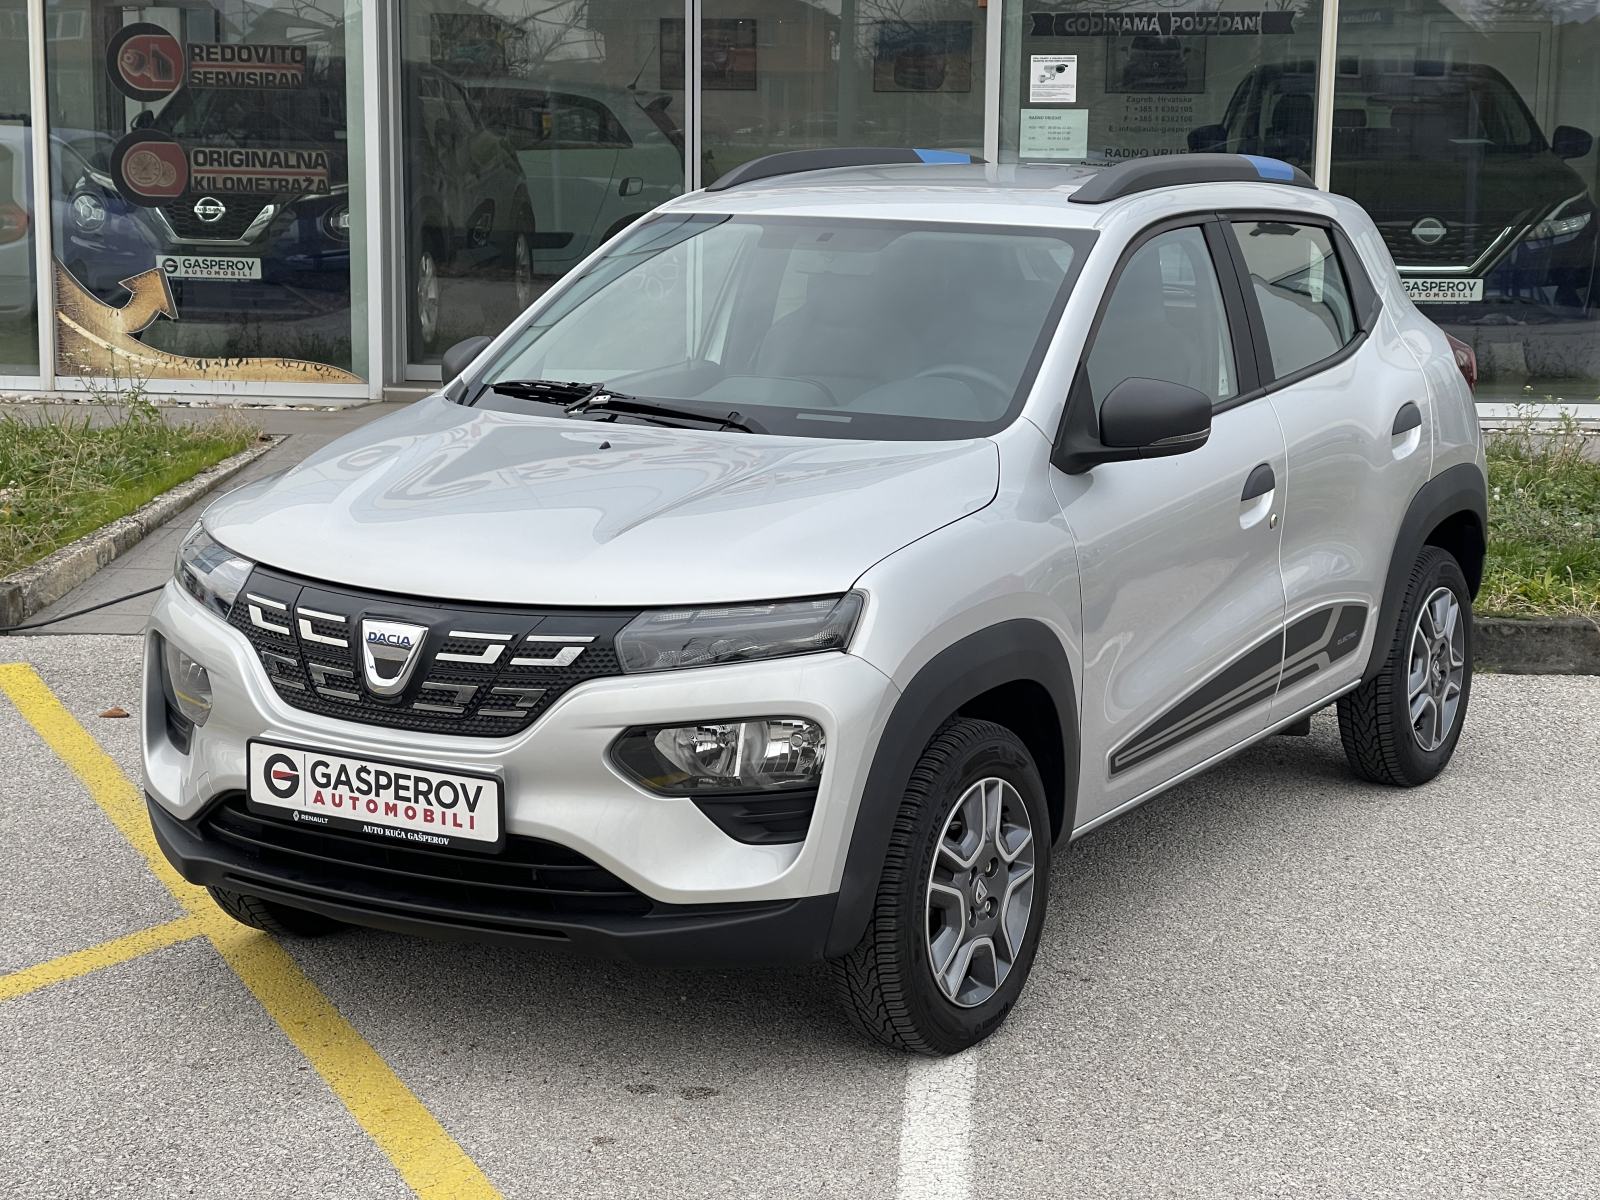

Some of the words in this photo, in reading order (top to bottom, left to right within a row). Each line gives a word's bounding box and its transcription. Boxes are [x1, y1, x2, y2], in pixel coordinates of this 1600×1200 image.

[1065, 17, 1160, 32] GODINAMA
[1171, 17, 1261, 32] POUZDANI
[191, 45, 305, 62] REDOVITO
[191, 71, 304, 87] SERVISIRAN
[193, 150, 327, 168] ORIGINALNA
[1105, 148, 1149, 158] RADNO
[193, 175, 328, 192] KILOMETRAŽA
[184, 269, 252, 277] AUTOMOBILI
[367, 631, 411, 647] DACIA
[310, 760, 483, 813] GAŠPEROV
[313, 790, 475, 830] AUTOMOBILI
[301, 814, 329, 824] RENAULT
[362, 825, 383, 835] AUTO
[385, 828, 406, 839] KUĆA
[408, 831, 450, 845] GAŠPEROV
